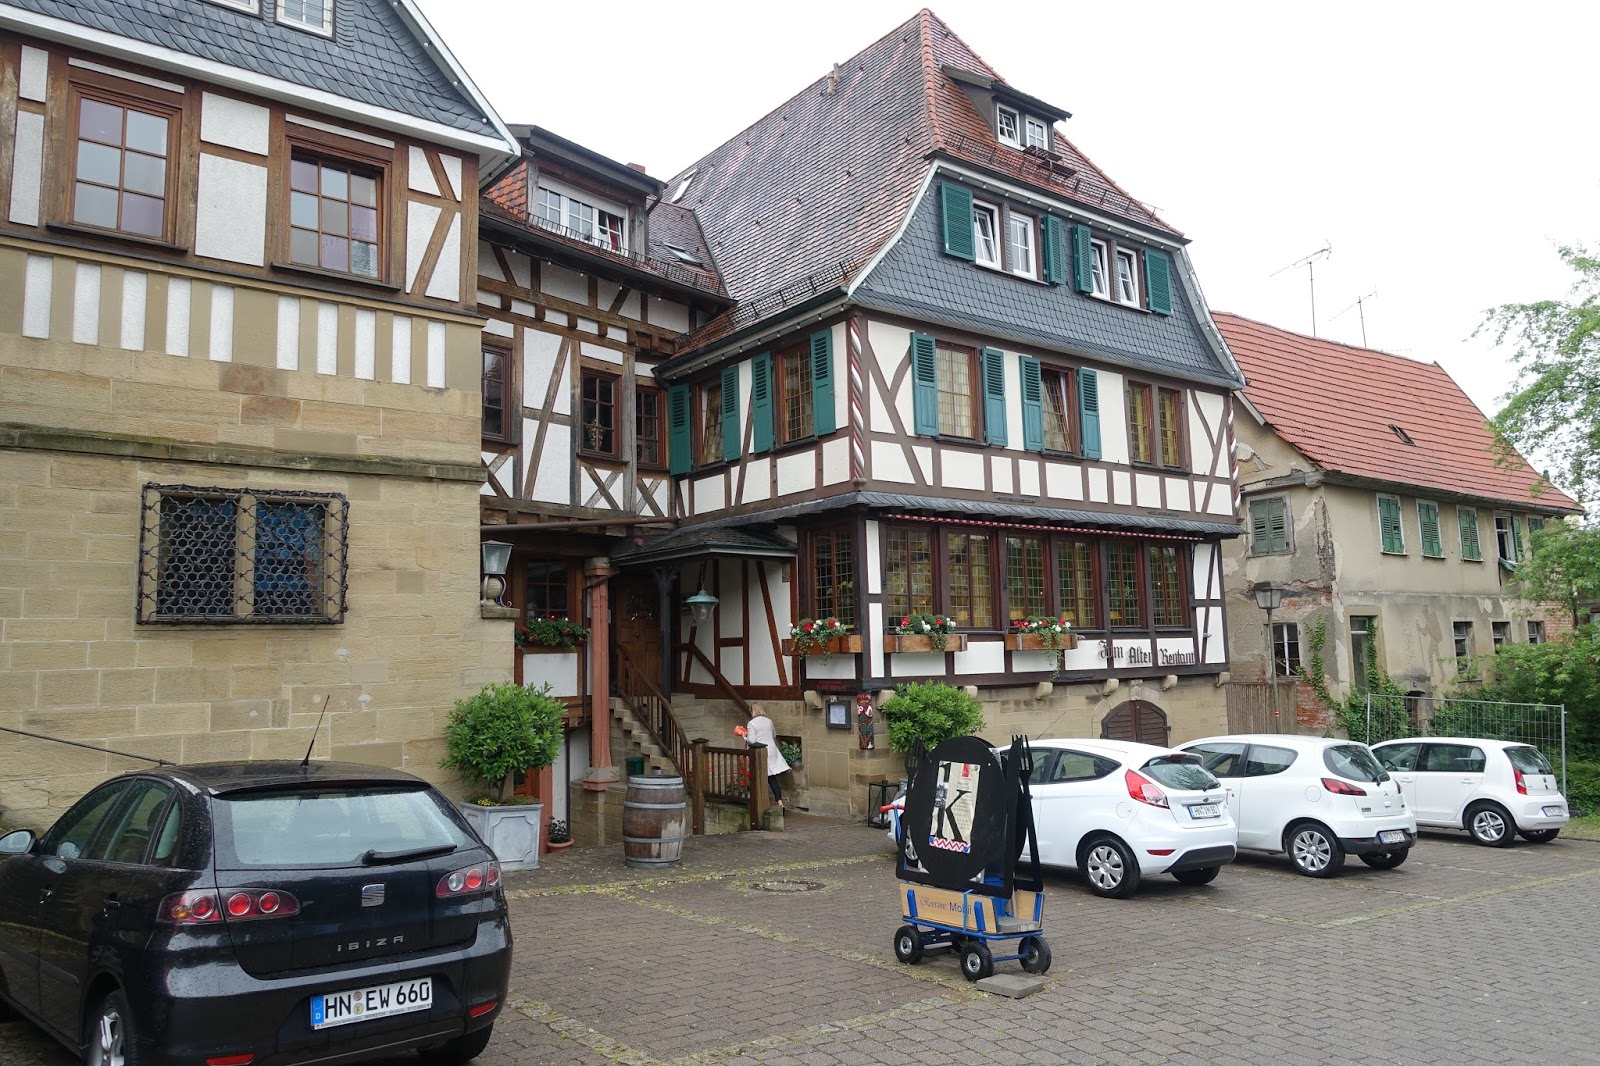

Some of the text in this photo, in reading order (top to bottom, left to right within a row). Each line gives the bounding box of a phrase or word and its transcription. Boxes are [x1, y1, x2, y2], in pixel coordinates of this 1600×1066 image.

[1159, 648, 1196, 665] Rentam
[949, 901, 972, 915] Moil
[325, 982, 430, 1019] HN EW 660
[315, 1012, 321, 1020] D
